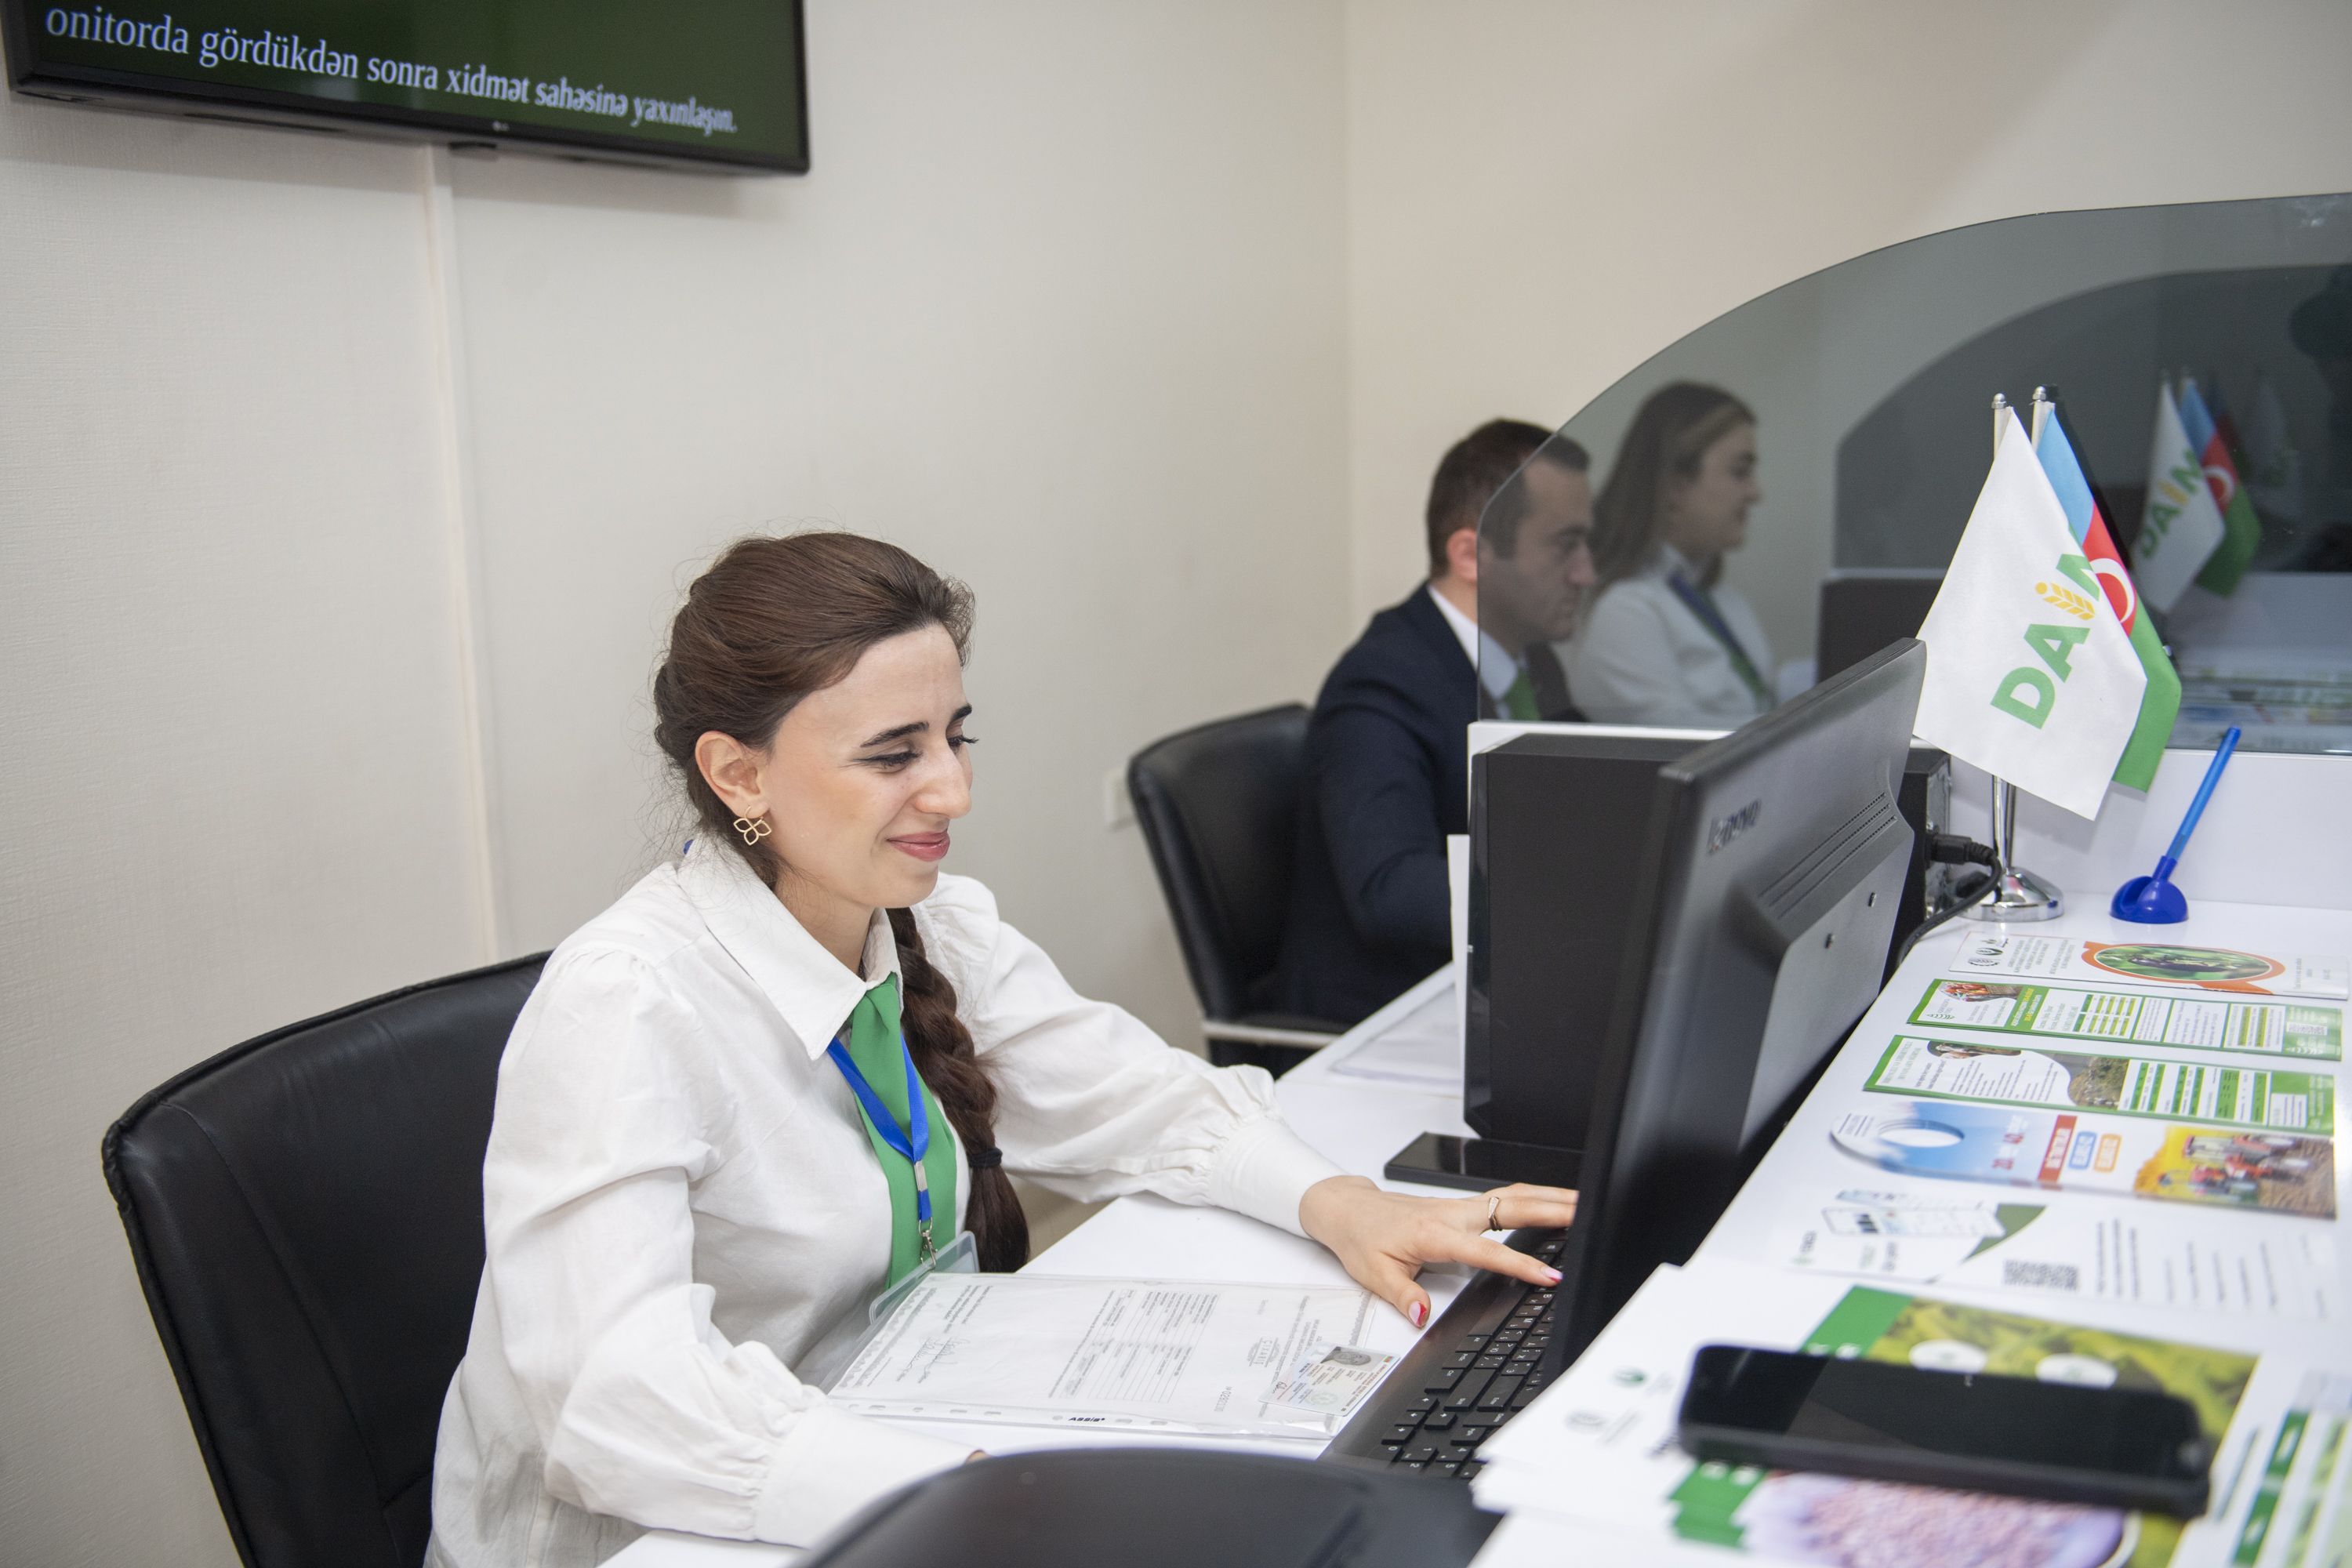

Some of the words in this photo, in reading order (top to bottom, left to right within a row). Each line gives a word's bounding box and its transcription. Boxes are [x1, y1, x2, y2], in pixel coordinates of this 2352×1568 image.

[45, 5, 188, 54] onitorda
[199, 27, 358, 78] gördükdən
[367, 56, 437, 90] sonra
[445, 64, 531, 103] xidmət
[535, 77, 629, 117] sahəsinə
